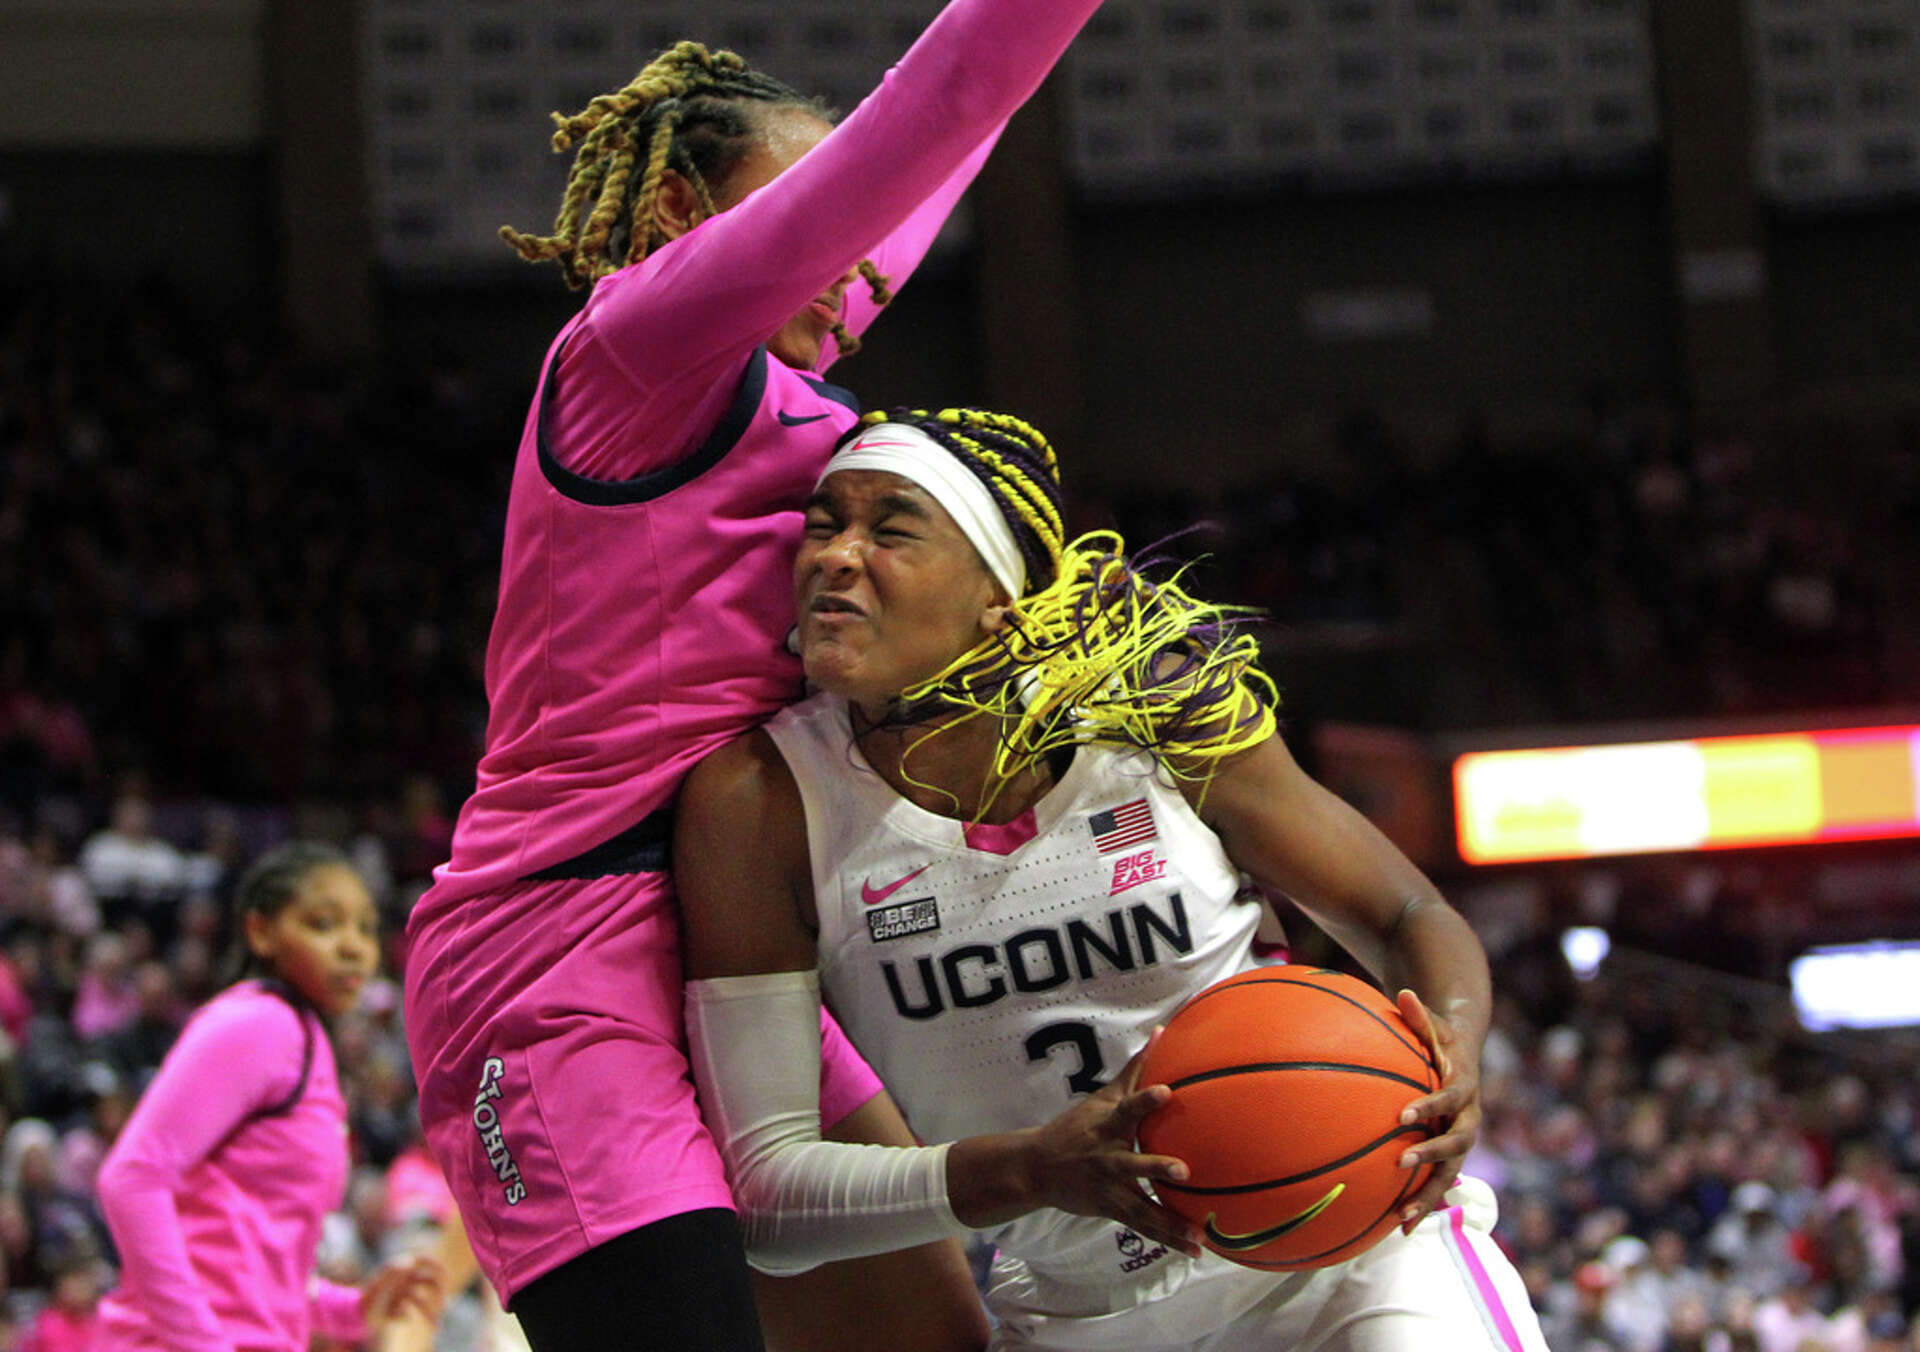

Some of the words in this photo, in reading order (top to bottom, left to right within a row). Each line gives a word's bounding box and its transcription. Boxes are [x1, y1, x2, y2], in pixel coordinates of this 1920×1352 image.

[1111, 859, 1168, 889] EAST
[1114, 849, 1154, 874] BIG
[873, 915, 937, 940] CHANGE
[880, 892, 1193, 1020] UCONN
